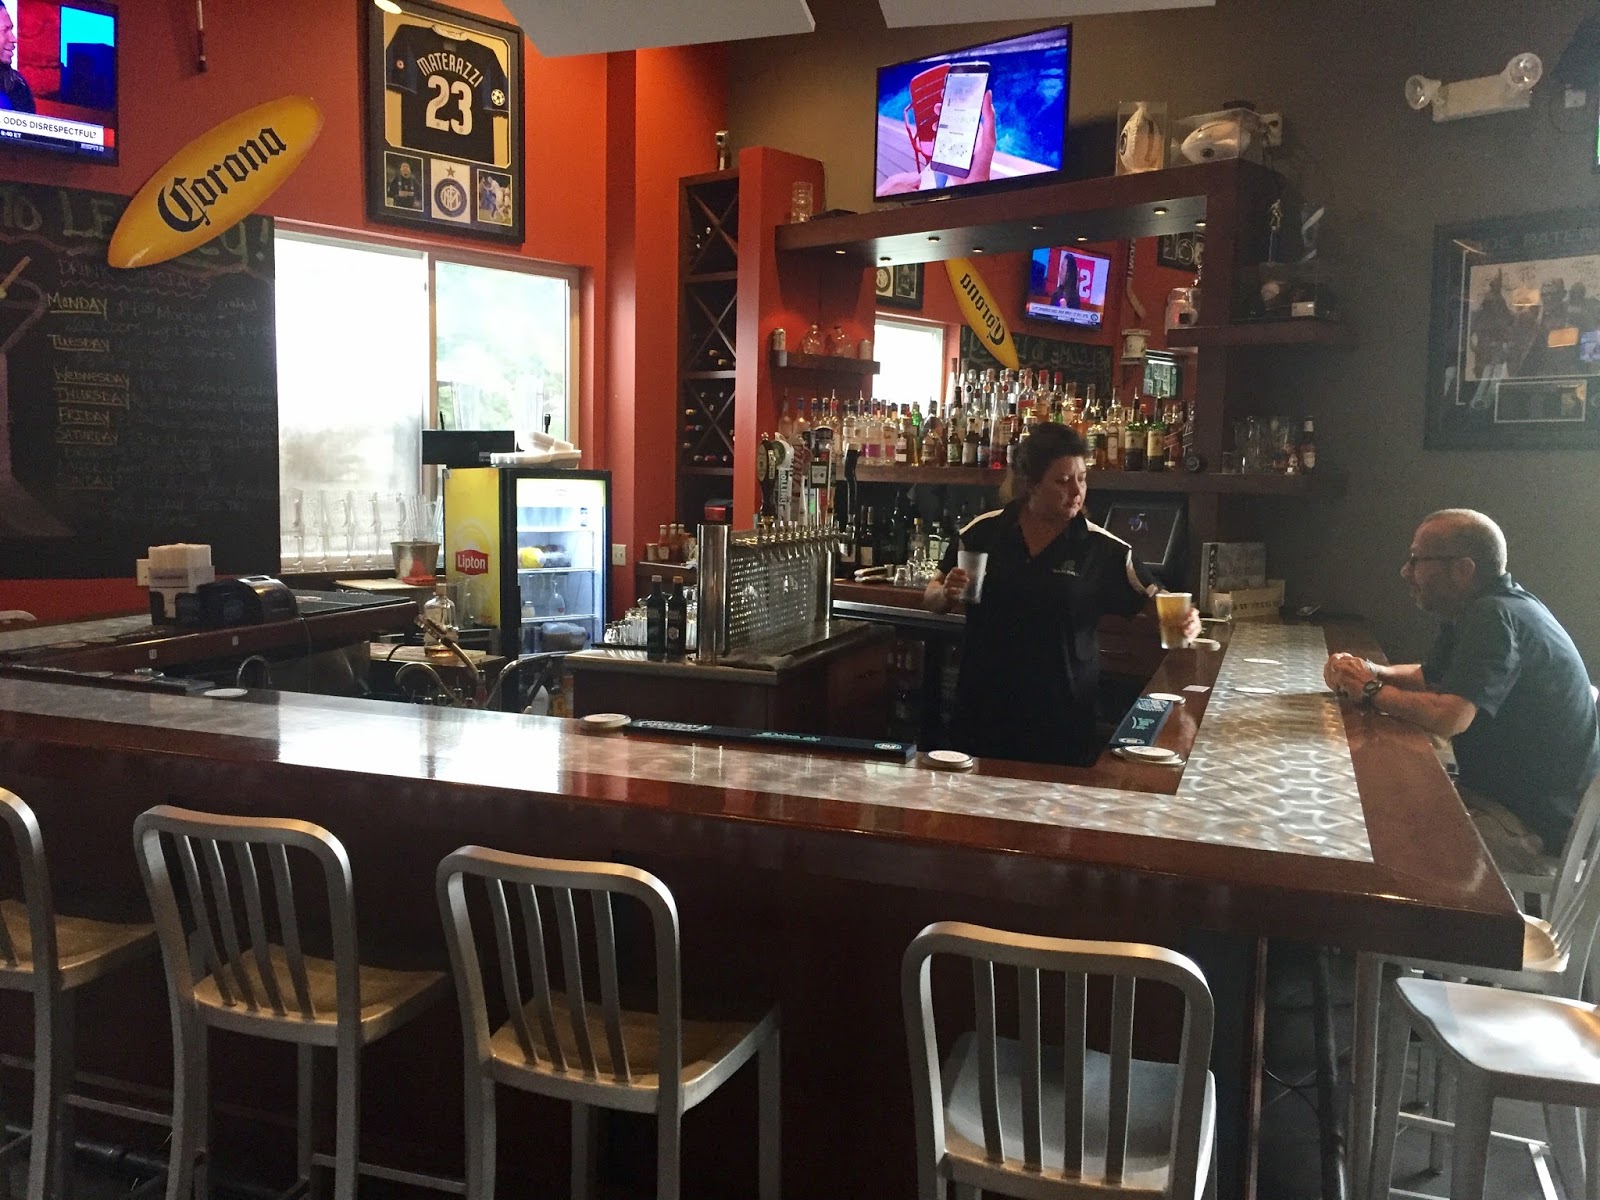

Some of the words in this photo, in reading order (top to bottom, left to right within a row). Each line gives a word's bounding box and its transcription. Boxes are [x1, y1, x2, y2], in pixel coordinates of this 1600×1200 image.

[417, 52, 484, 88] MATERAZZI
[426, 75, 472, 135] 23
[3, 117, 28, 128] ODDS
[29, 120, 97, 139] DISRESPECTFUL?
[157, 127, 287, 232] Corona
[47, 292, 108, 320] MONDAY
[47, 334, 110, 353] TUESDAY
[53, 365, 130, 391] WEDNESDAY
[58, 406, 110, 428] FRIDAY
[458, 554, 485, 571] Lipton
